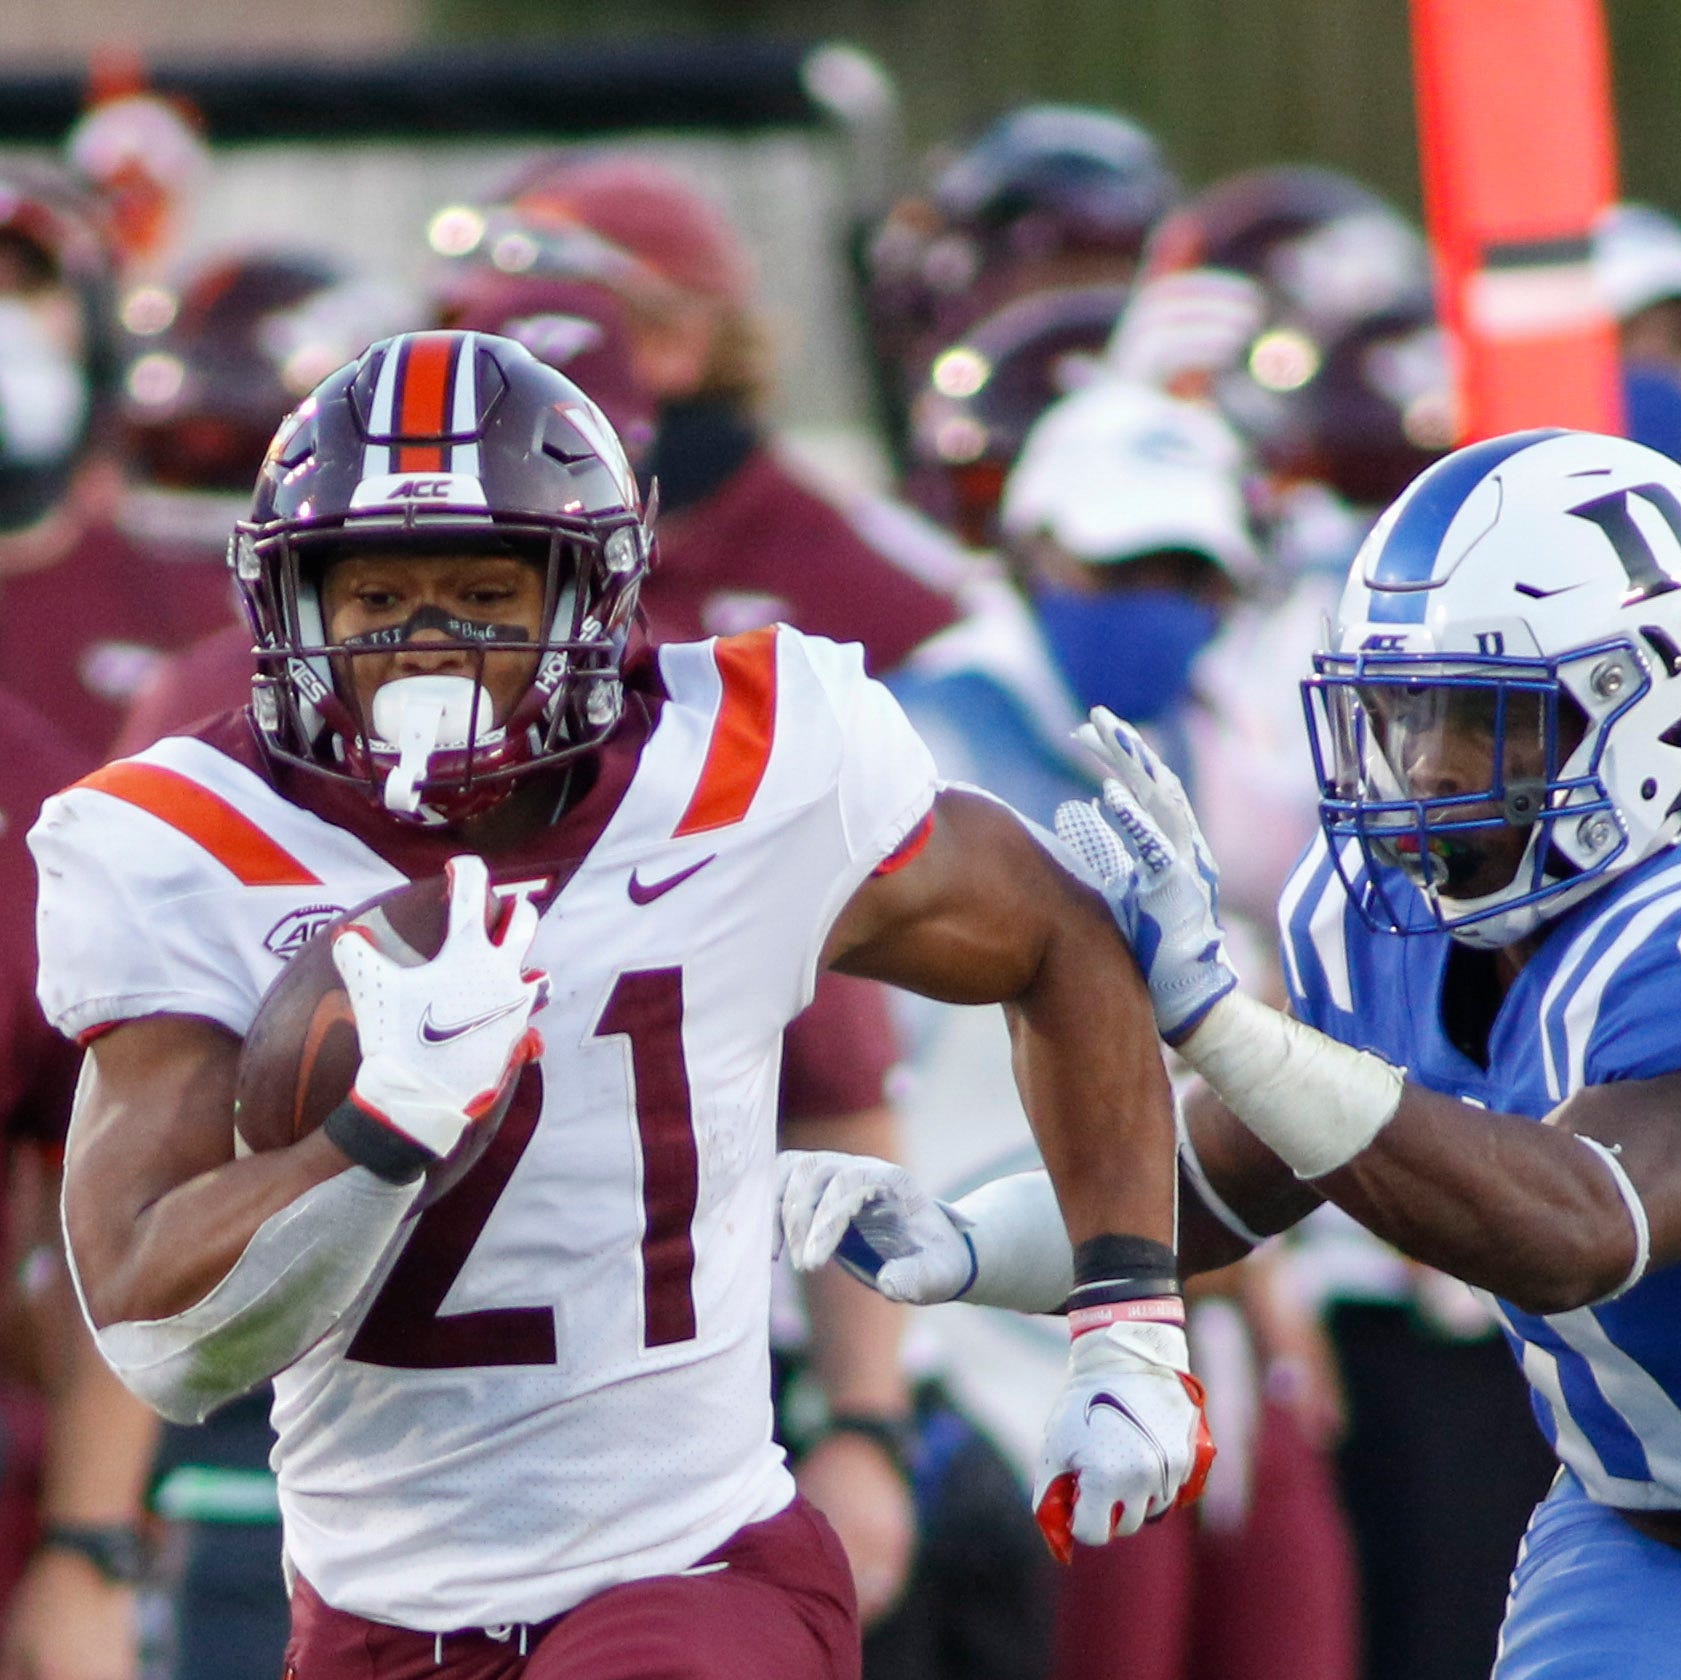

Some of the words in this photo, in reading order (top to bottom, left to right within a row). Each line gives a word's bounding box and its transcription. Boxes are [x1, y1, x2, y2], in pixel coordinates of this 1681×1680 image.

[387, 479, 453, 500] ACC
[1115, 806, 1172, 874] DUKE
[343, 964, 698, 1367] 21
